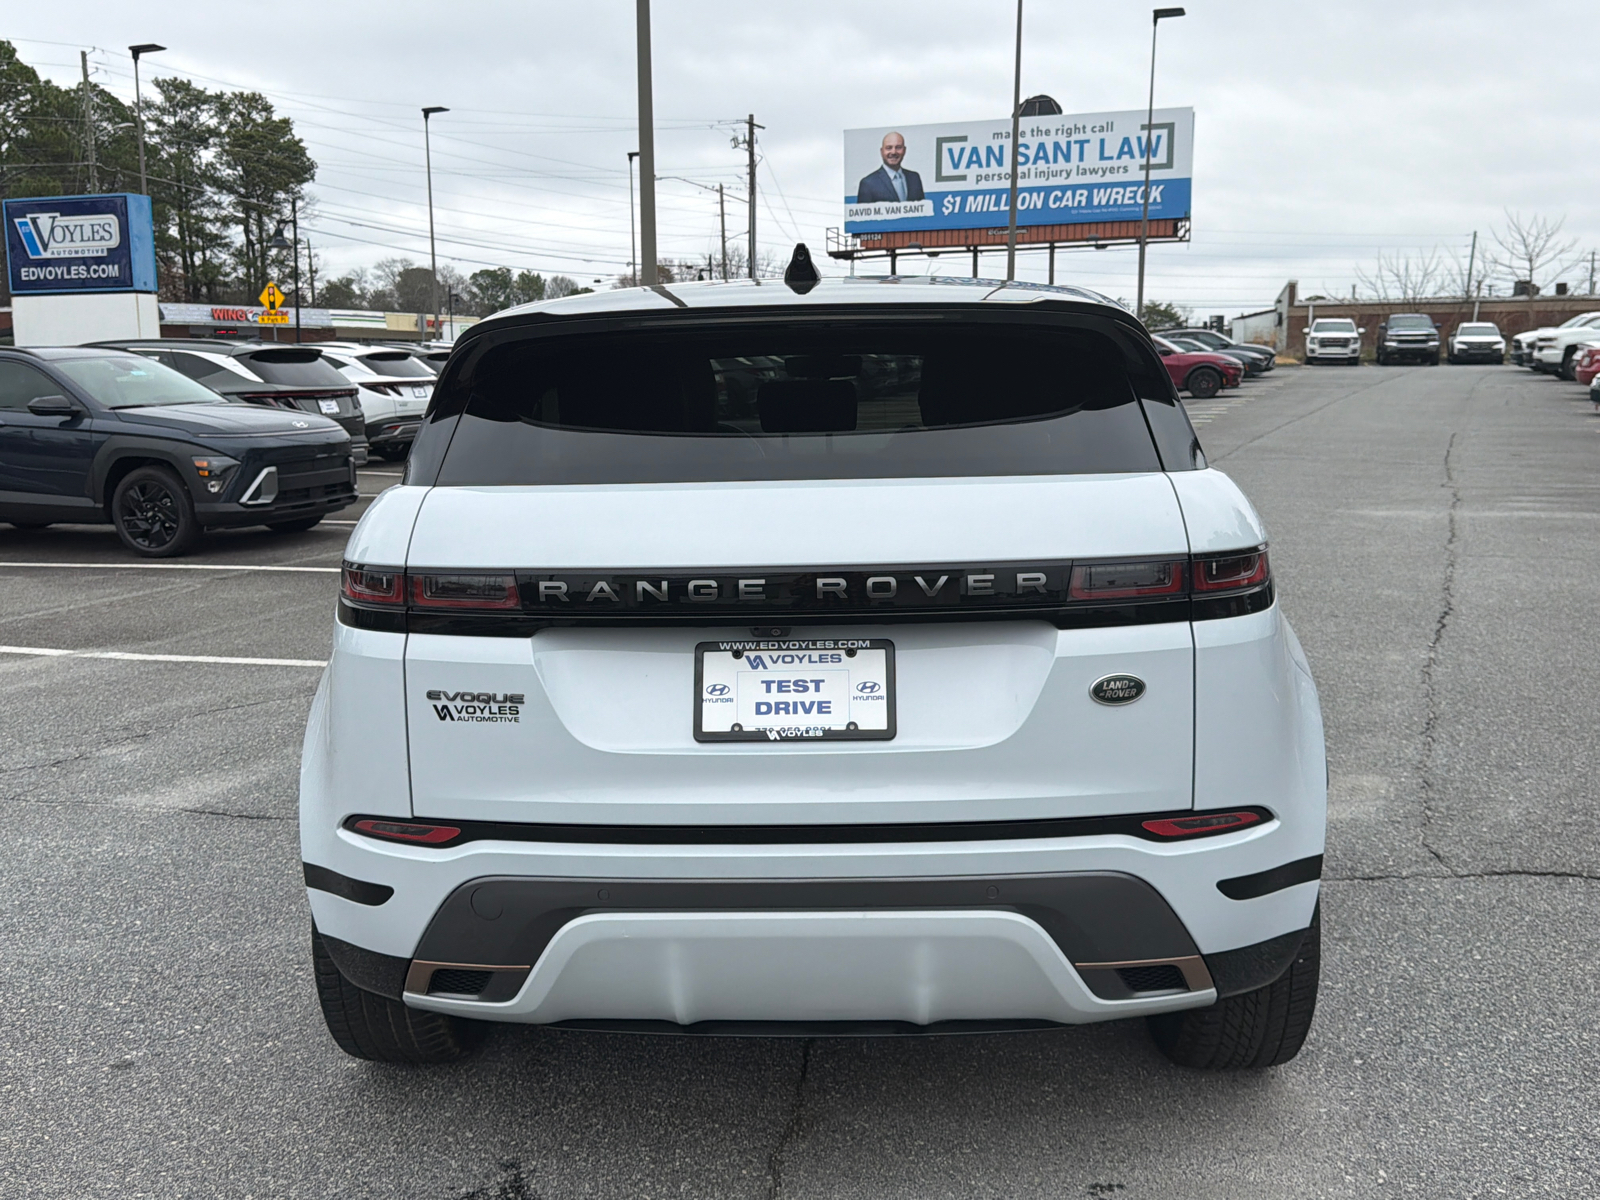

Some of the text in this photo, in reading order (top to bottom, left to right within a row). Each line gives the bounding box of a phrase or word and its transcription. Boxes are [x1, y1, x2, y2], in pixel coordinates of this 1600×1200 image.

[992, 121, 1114, 140] mae the right call
[947, 134, 1162, 170] VAN SANT LAW
[976, 164, 1129, 185] persoal injury lawyers
[942, 185, 1165, 216] $1 MILLON CAR WRECK
[849, 204, 925, 218] DAVID M. VAN SANT
[51, 248, 105, 256] AUTOMOTIVE
[20, 264, 119, 281] EDVOYLES.COM
[211, 308, 246, 321] WING
[538, 572, 1048, 603] RANGE ROVER
[719, 640, 870, 651] WWW.EDVOYLES.COM
[768, 653, 842, 665] VOYLES
[760, 679, 826, 694] TEST
[1102, 680, 1129, 690] LAND
[426, 689, 525, 705] EVOQUE
[1105, 688, 1137, 698] ROVER
[453, 705, 520, 716] VOYLES
[755, 700, 832, 716] DRIVE
[456, 715, 520, 723] AUTOMOTIVE
[780, 729, 823, 737] VOYLES
